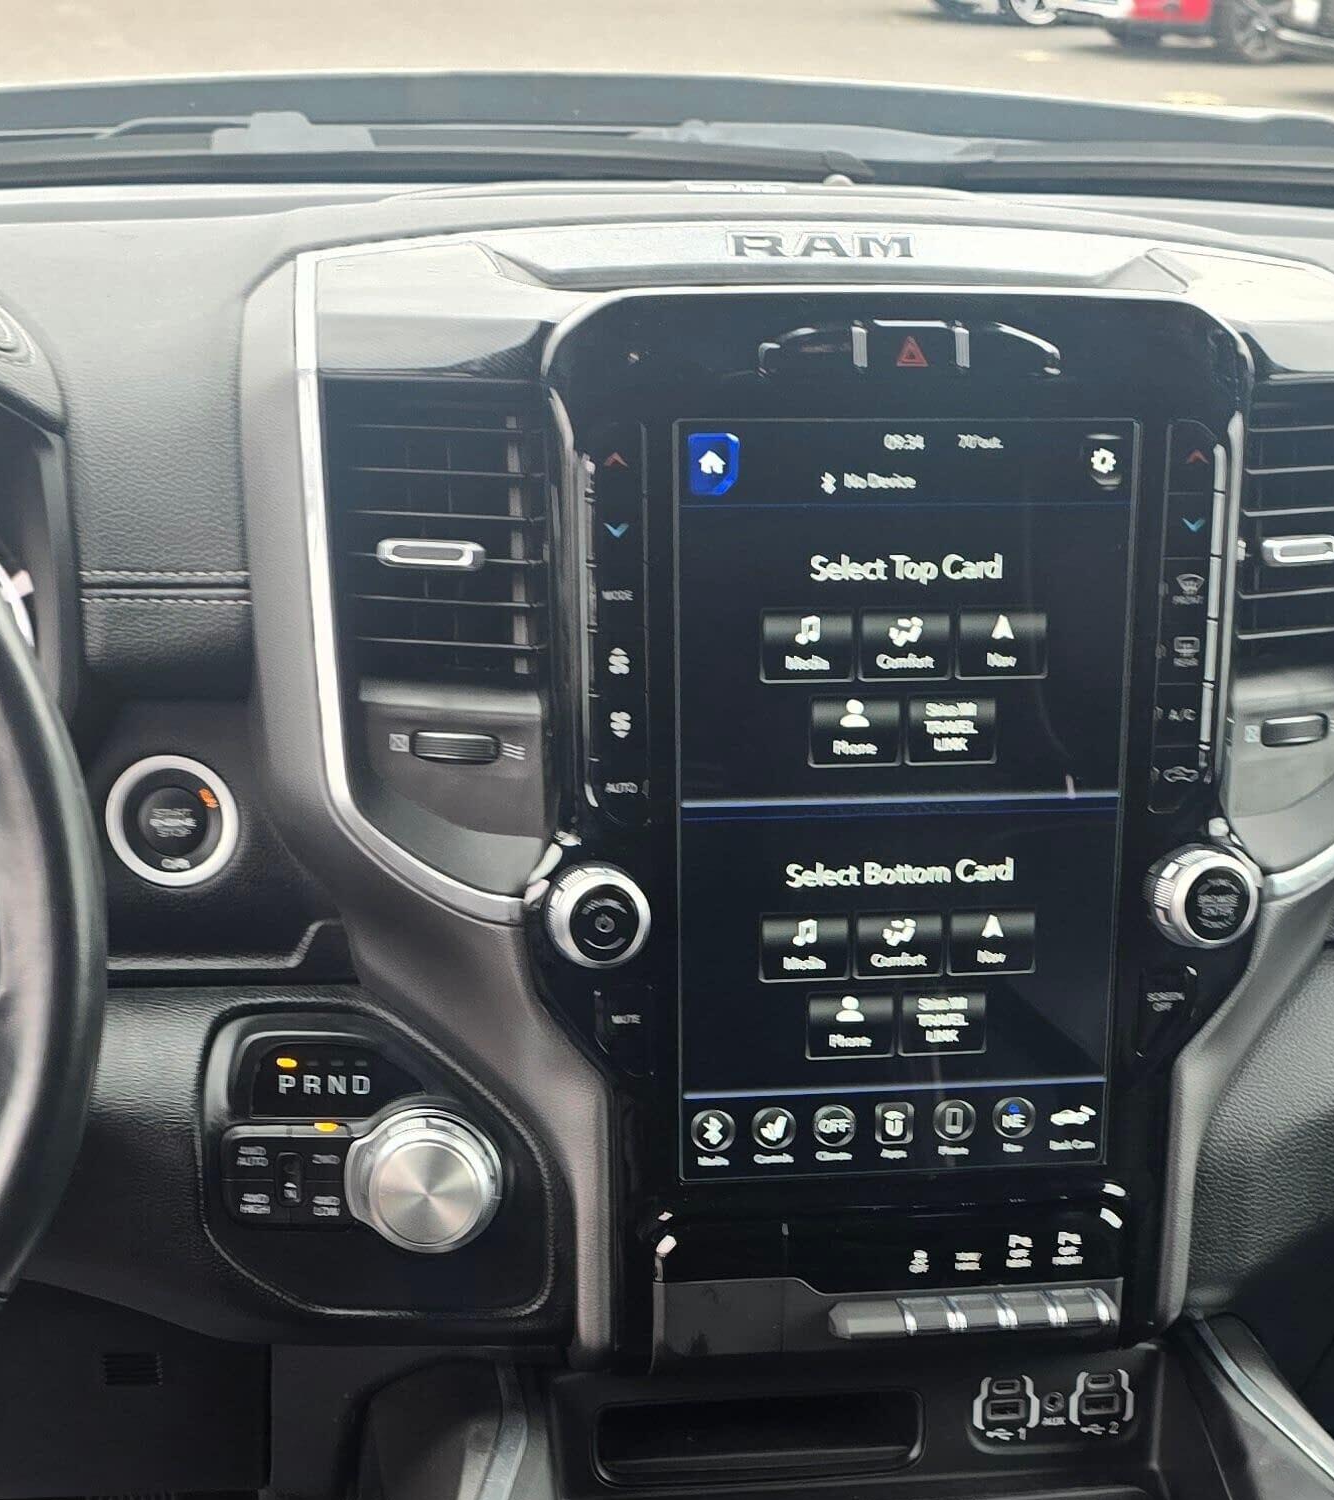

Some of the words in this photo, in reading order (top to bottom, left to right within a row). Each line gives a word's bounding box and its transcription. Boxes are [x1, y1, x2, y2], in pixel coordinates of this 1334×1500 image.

[726, 231, 915, 258] RAM
[810, 555, 888, 582] Select
[889, 555, 939, 586] Top
[942, 553, 1003, 580] Card
[786, 861, 861, 888] Select
[863, 861, 952, 887] Bottom
[955, 856, 1014, 884] Card
